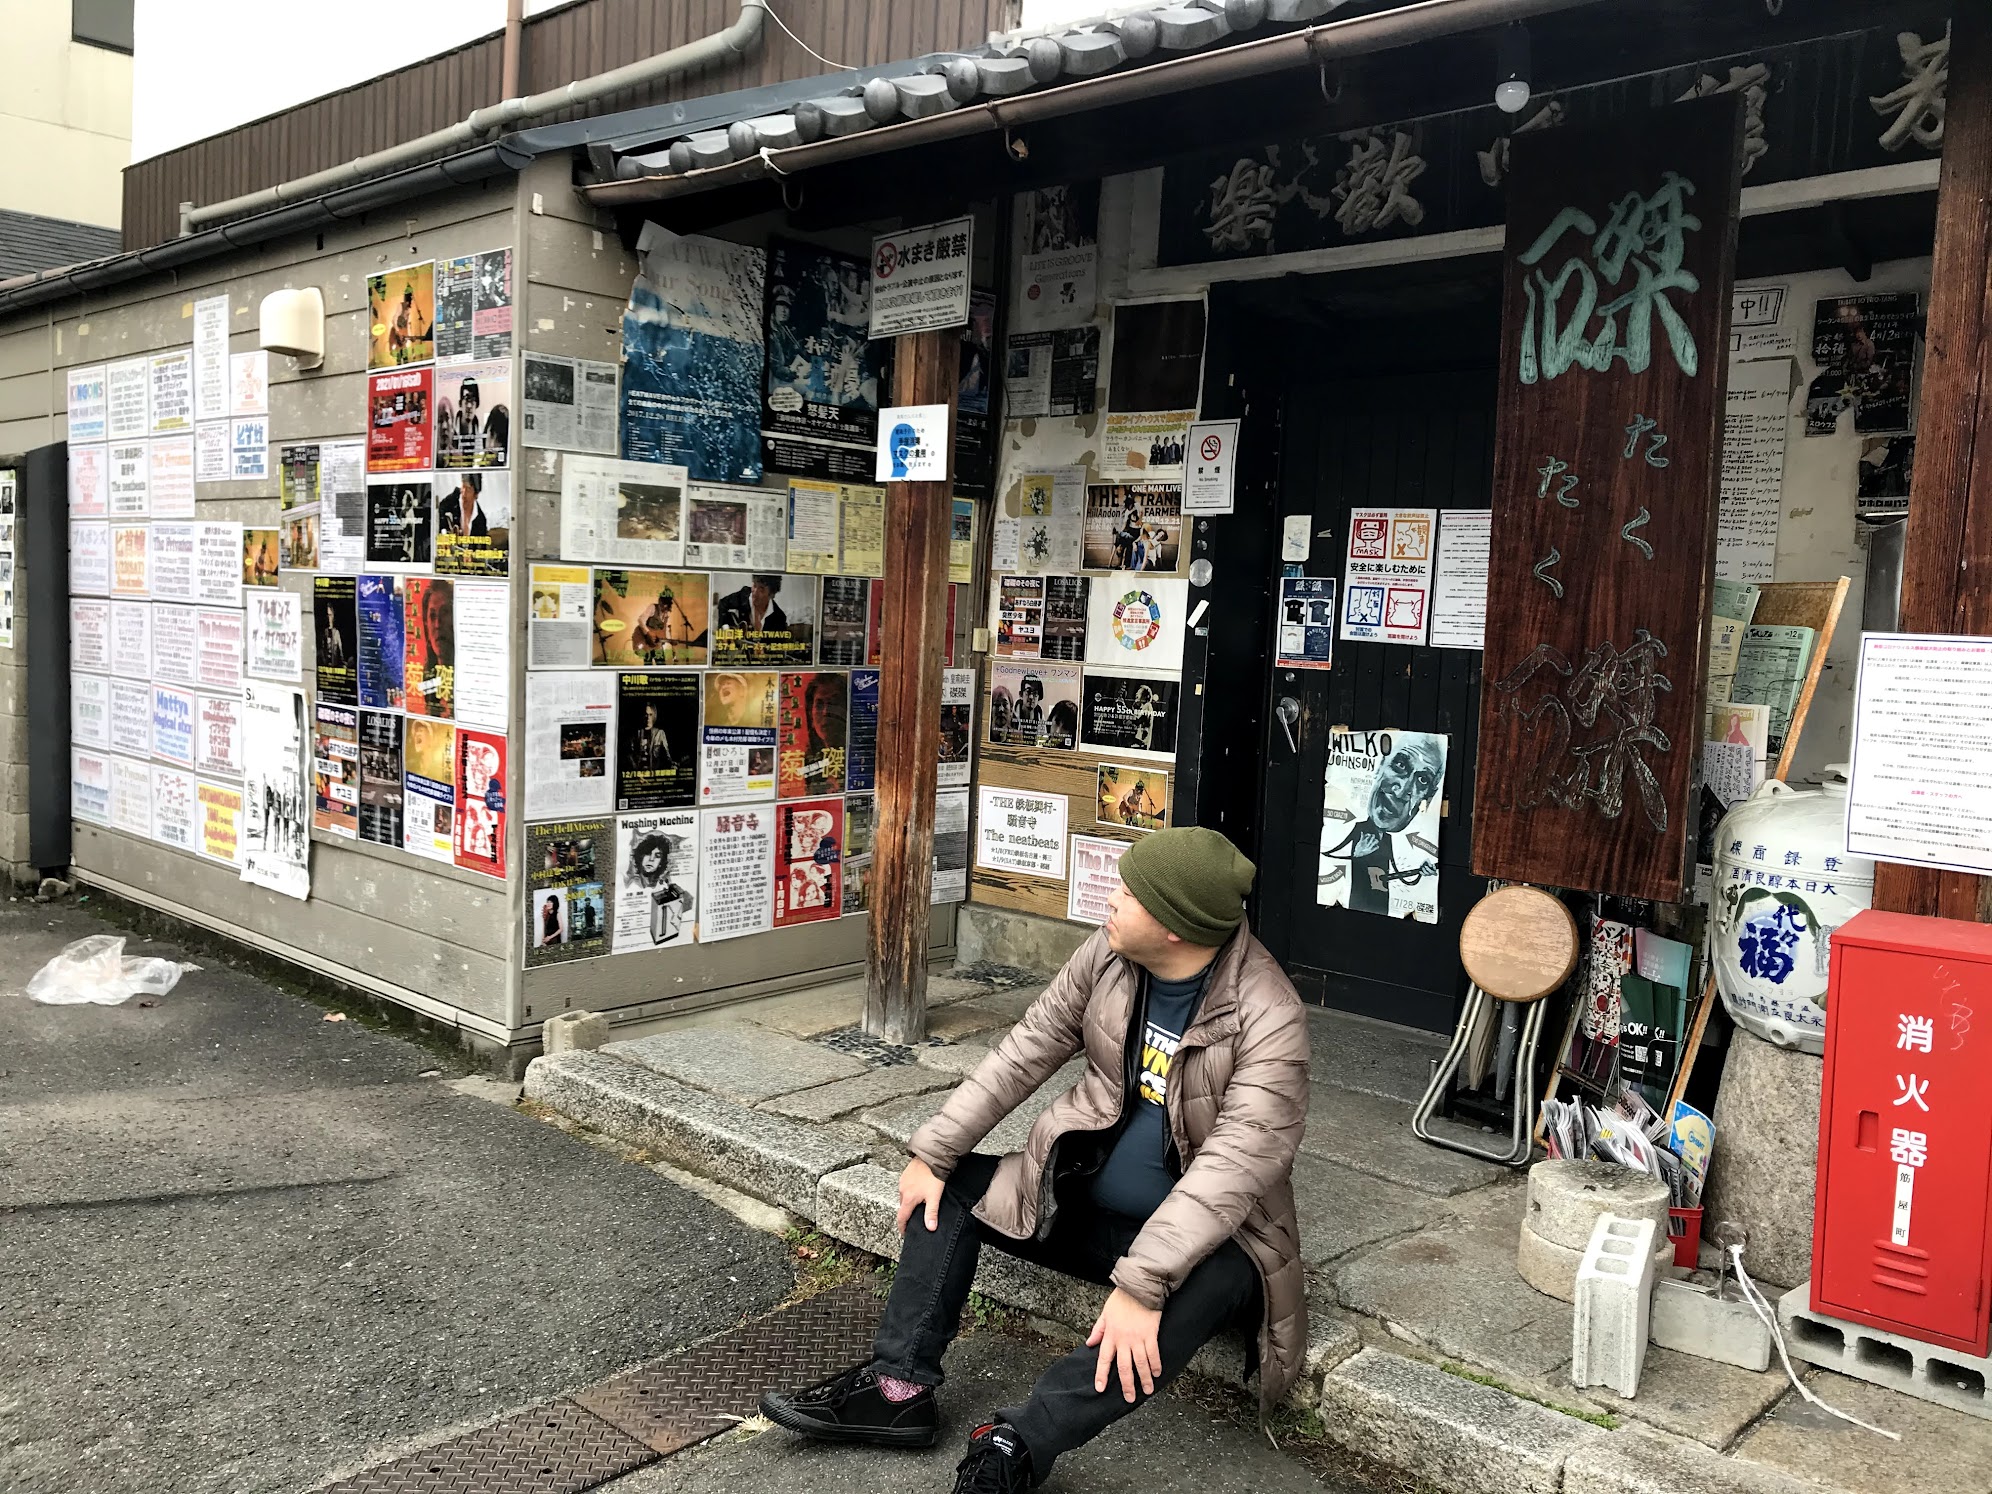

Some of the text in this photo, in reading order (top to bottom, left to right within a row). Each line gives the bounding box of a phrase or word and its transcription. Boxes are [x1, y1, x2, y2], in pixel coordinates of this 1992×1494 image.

[897, 233, 967, 268] 水まき厳禁
[807, 403, 840, 421] 怒髪天
[1132, 484, 1182, 493] ONE MAN LIVE
[1355, 548, 1380, 557] MASK
[1350, 562, 1426, 575] 安全に楽しむために
[1745, 586, 1752, 594] 8
[715, 629, 791, 640] 山口洋 (HEATWAVE)
[1018, 626, 1035, 634] ヤユヨ
[1725, 625, 1735, 633] 12
[1051, 669, 1077, 678] ワンマン
[1331, 732, 1393, 757] WILKO
[1328, 754, 1376, 772] JOHNSON
[621, 814, 694, 829] Washing Machine
[716, 813, 760, 833] 騒音寺
[984, 829, 1060, 850] The neatbeats
[1077, 850, 1102, 871] The
[1394, 898, 1414, 910] 7/28
[1889, 1013, 1934, 1168] 消火器
